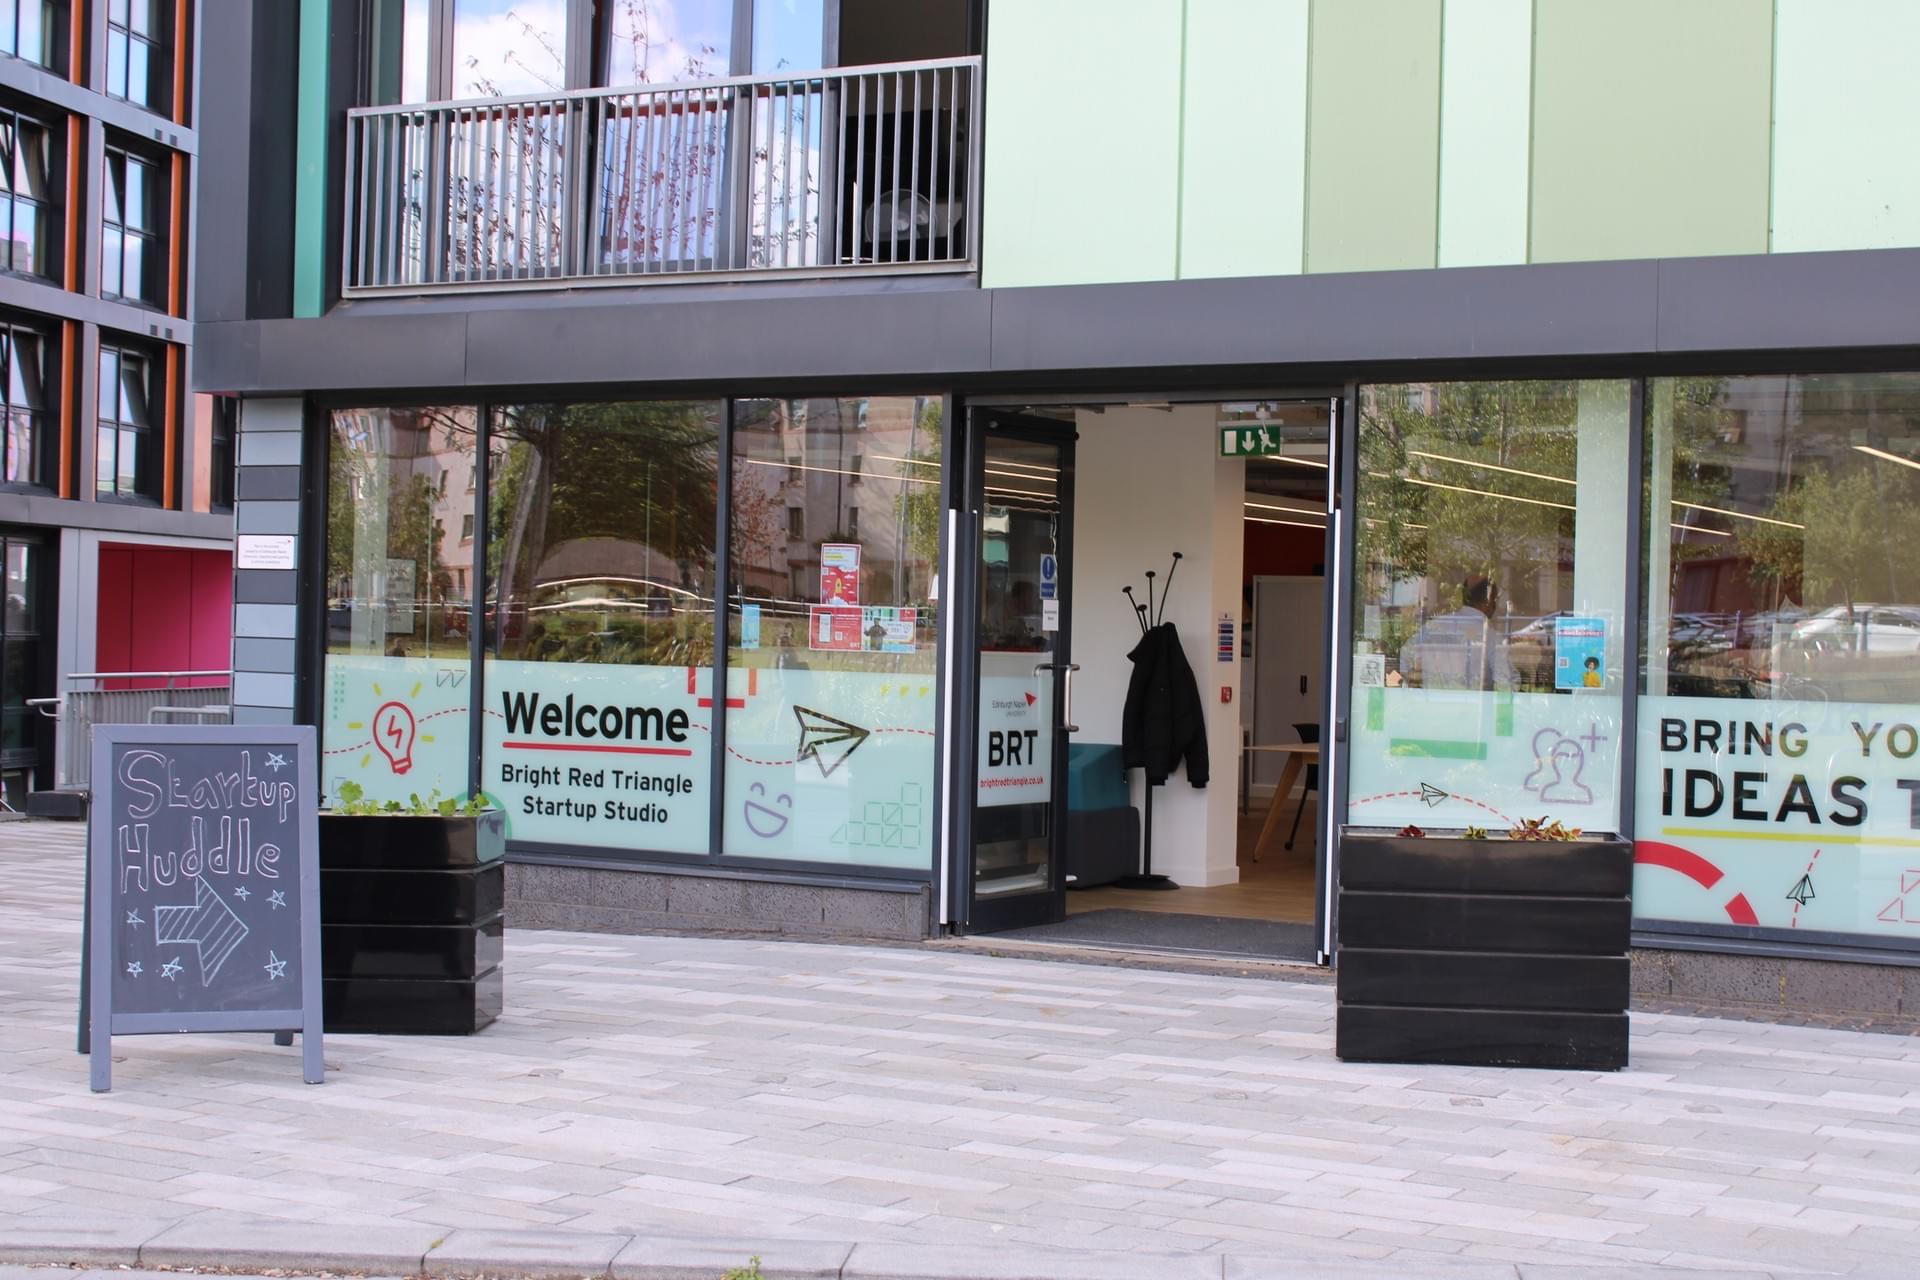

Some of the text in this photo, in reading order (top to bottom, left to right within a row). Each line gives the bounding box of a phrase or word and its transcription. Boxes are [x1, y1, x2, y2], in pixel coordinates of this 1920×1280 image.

[502, 691, 690, 742] Welcome
[988, 729, 1039, 767] BRT
[1660, 718, 1809, 758] BRING
[118, 750, 296, 824] Startup
[502, 763, 693, 797] Bright Red Triangle
[980, 775, 1044, 788] brightredtriangle.co.uk
[1662, 767, 1869, 827] IDEAS
[522, 795, 669, 824] Startup Studio
[118, 815, 281, 895] Huddle
